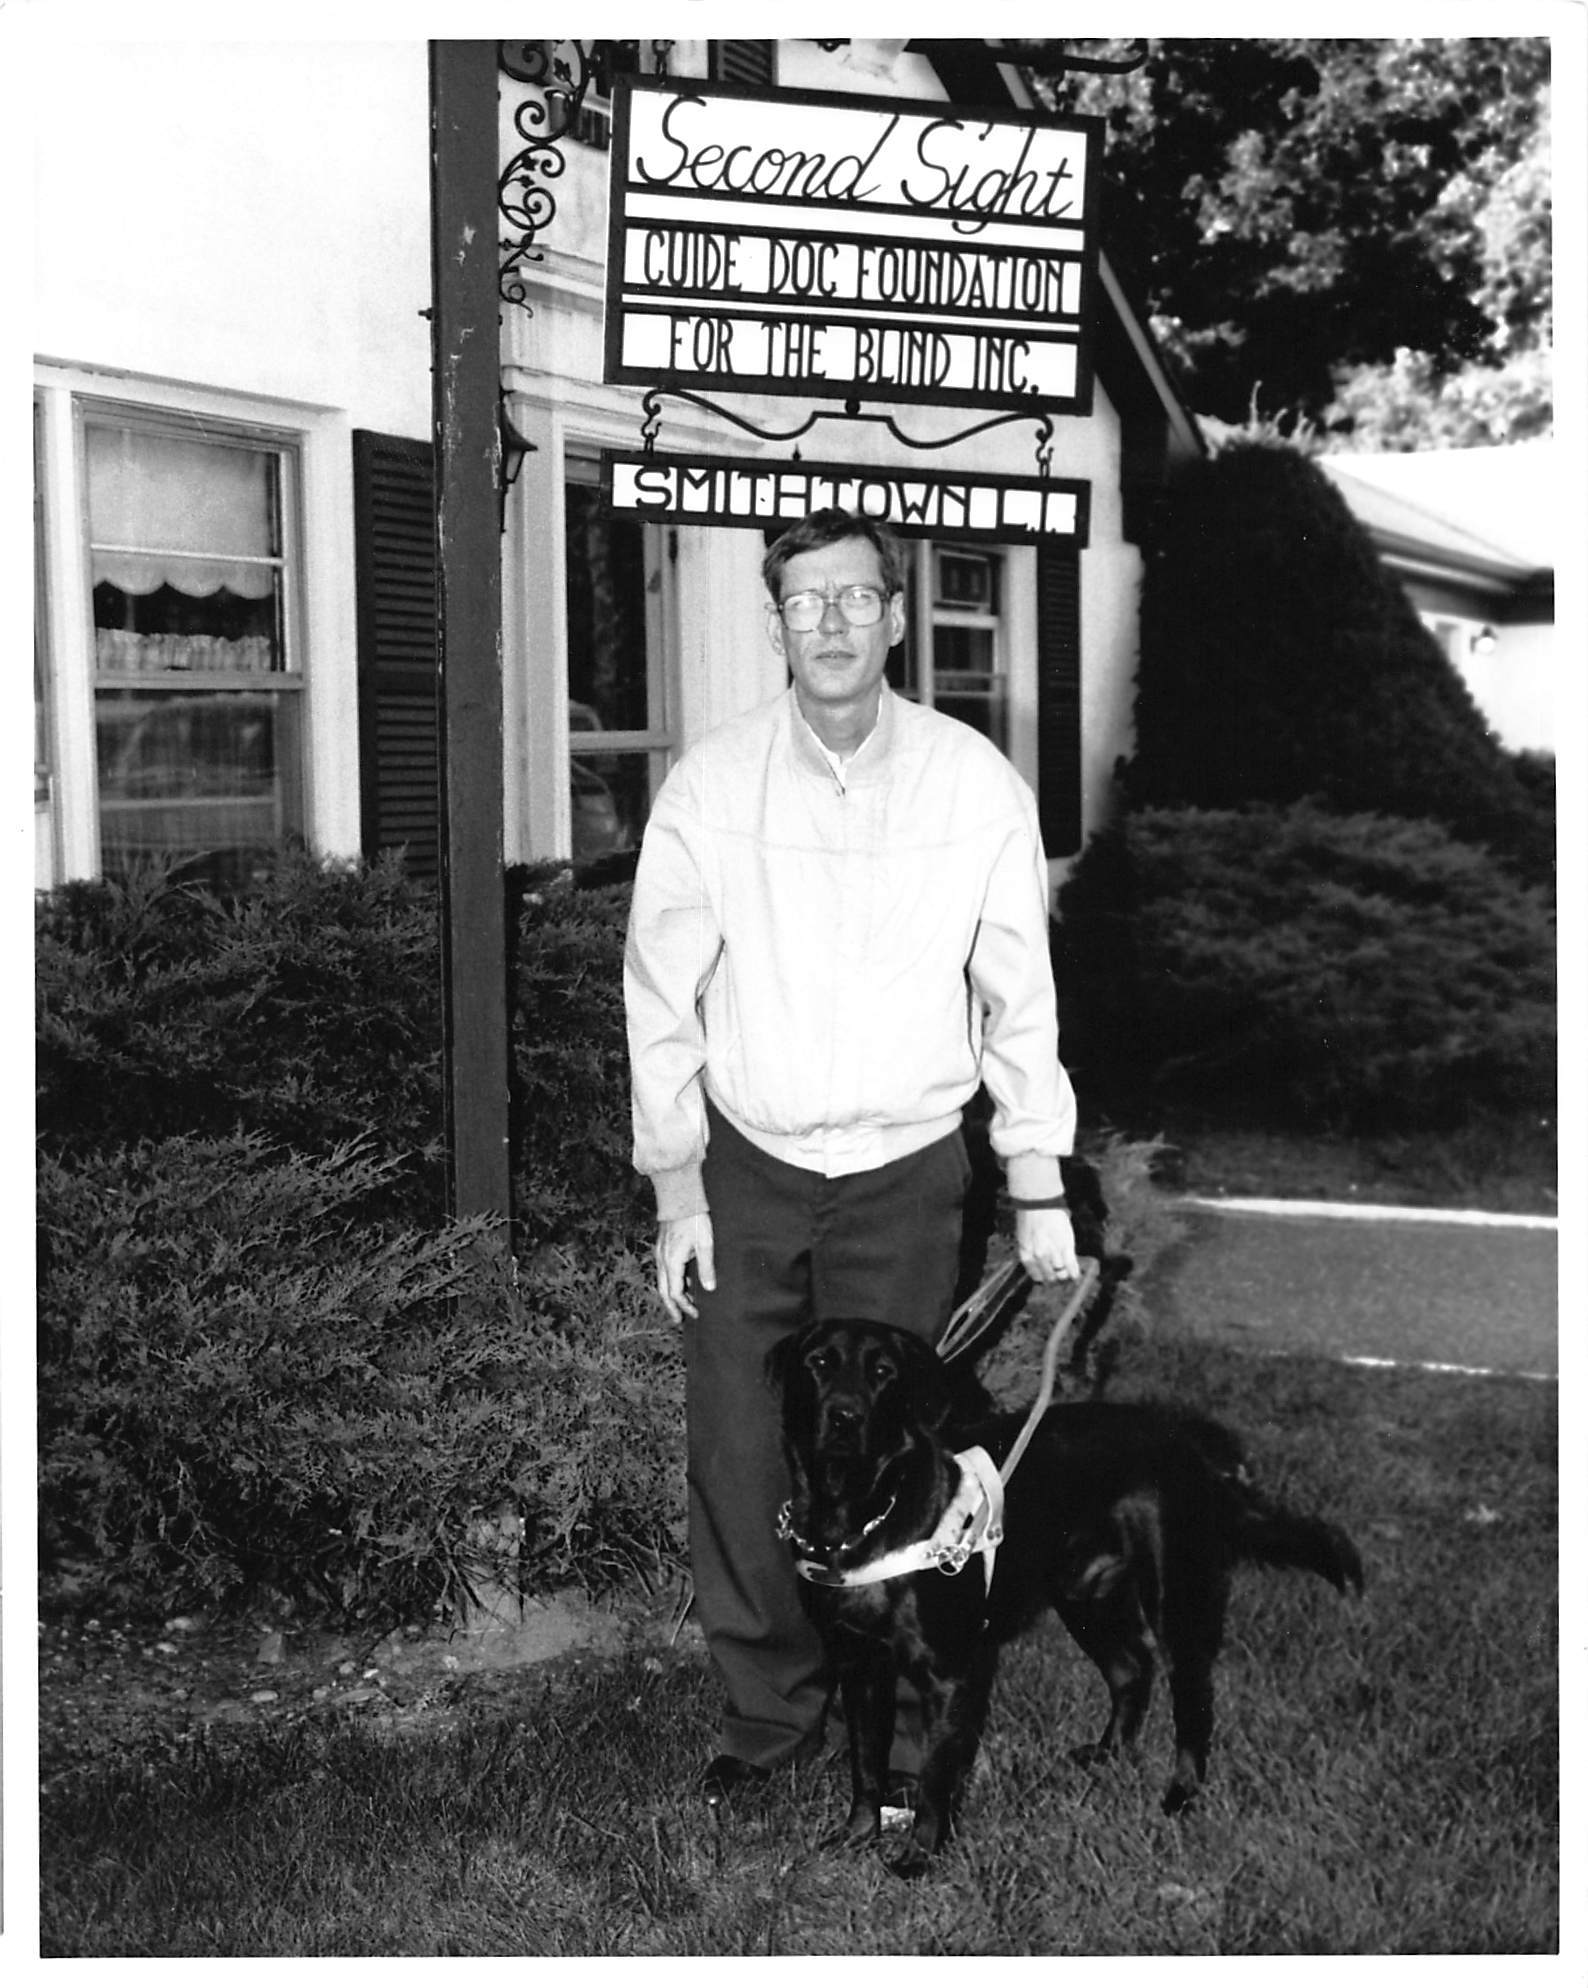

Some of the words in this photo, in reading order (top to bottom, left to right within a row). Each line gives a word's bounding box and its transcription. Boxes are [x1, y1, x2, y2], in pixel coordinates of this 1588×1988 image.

[636, 95, 899, 199] Second
[901, 119, 1074, 235] Sight
[857, 245, 1064, 314] FOUNDATION
[670, 314, 734, 375] FOR
[761, 321, 828, 380] THE
[854, 326, 951, 388] BLIND
[974, 335, 1040, 394] INC.
[634, 464, 970, 528] SMITHTOWN
